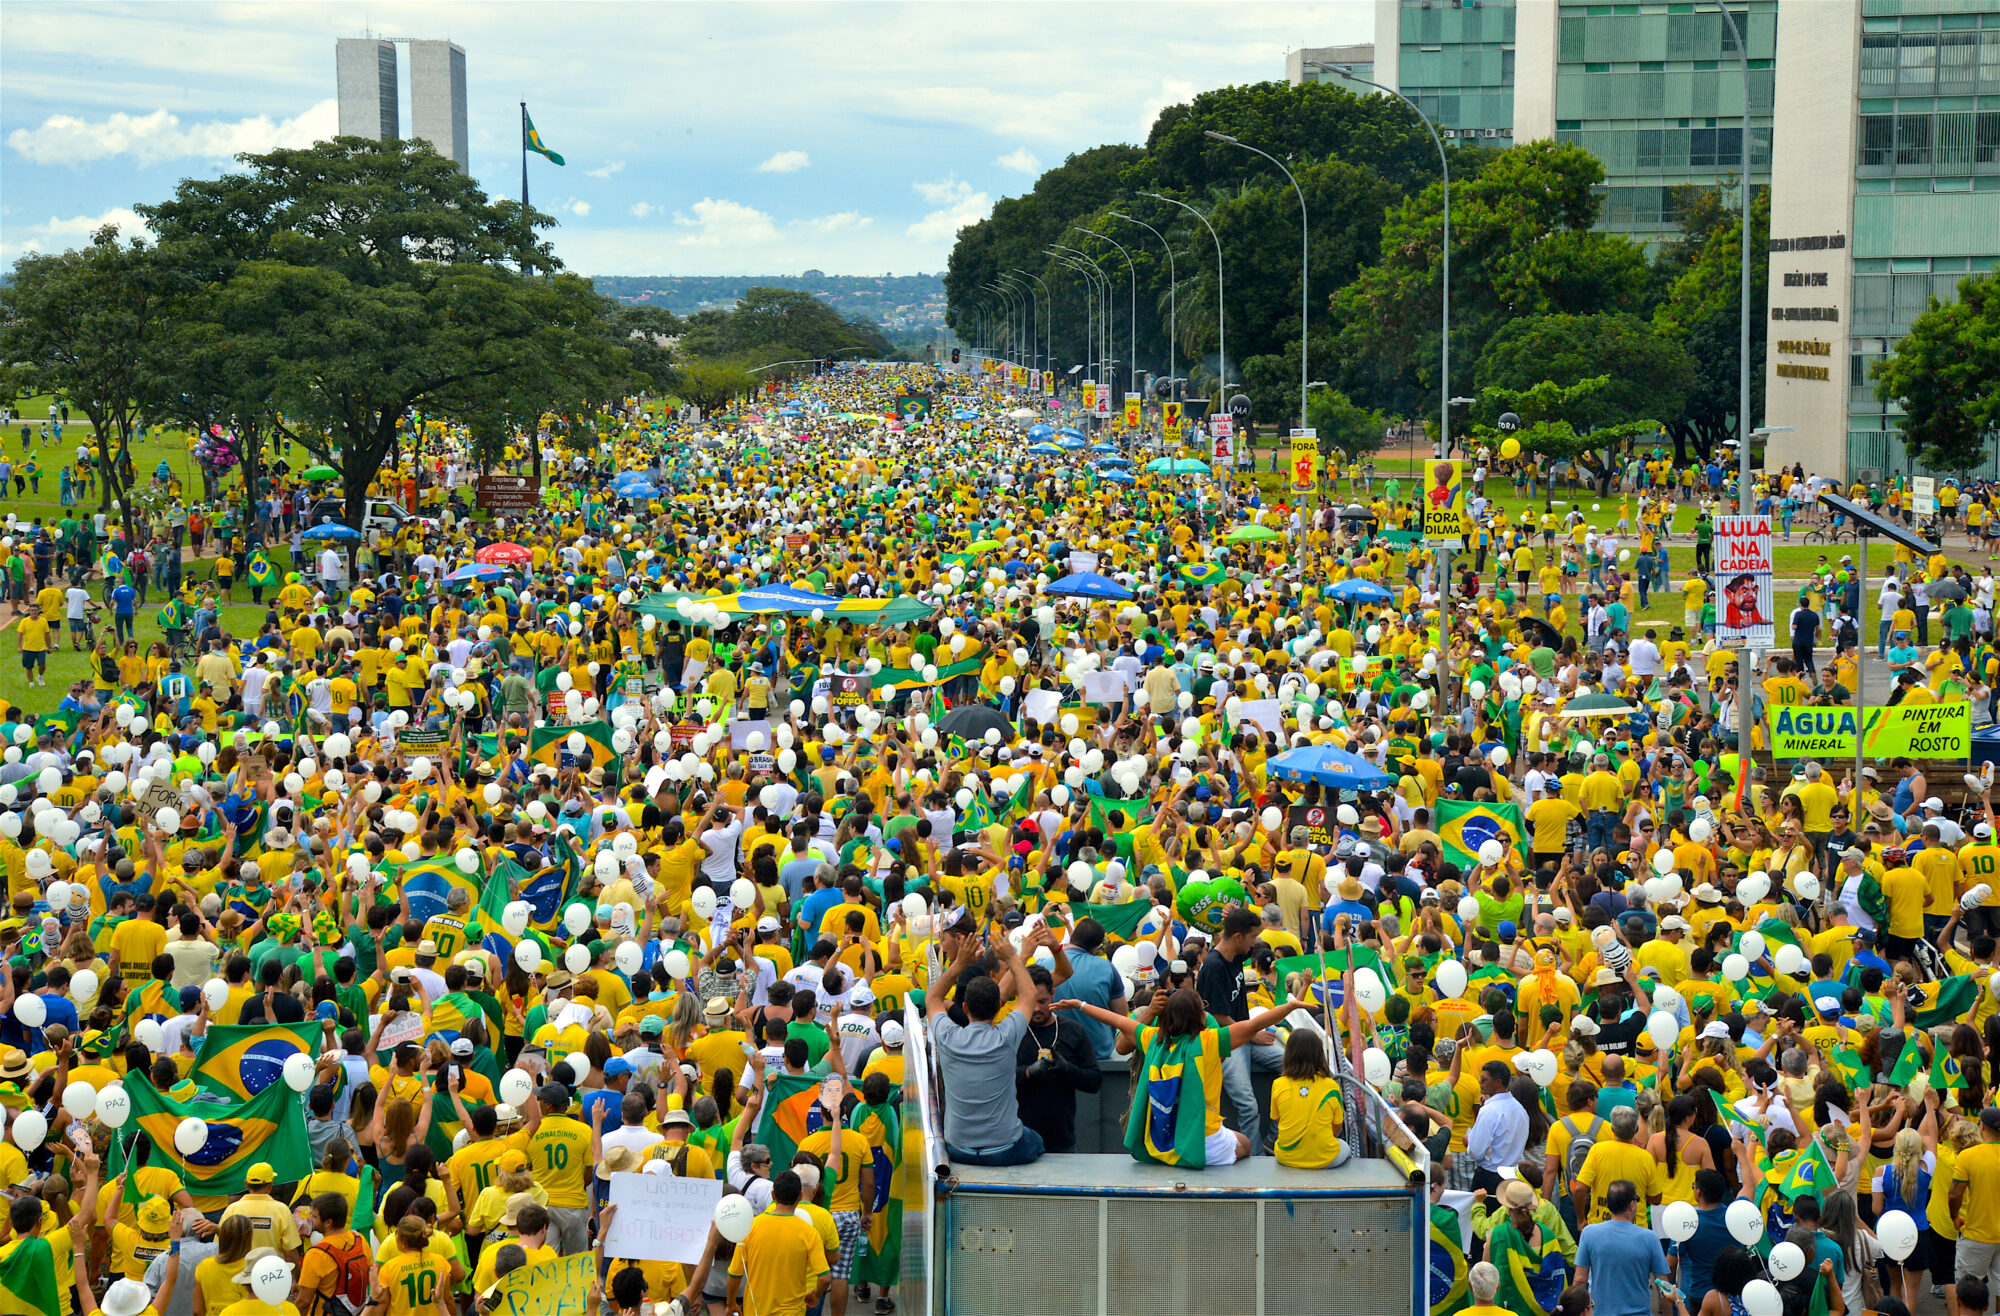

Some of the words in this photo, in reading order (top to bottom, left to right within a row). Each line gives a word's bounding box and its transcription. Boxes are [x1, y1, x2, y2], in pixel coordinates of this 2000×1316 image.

[1426, 513, 1460, 522] FORA
[1426, 526, 1460, 534] DILMA
[1720, 520, 1770, 537] LULA
[1731, 541, 1760, 556] NA
[1720, 559, 1770, 570] CADEIA
[598, 648, 606, 658] 10
[332, 691, 342, 704] 10
[1779, 686, 1796, 704] 10
[1903, 706, 1964, 720] PINTURA
[1776, 708, 1857, 736] ÁGUA
[1918, 722, 1940, 734] EM
[1784, 739, 1846, 750] MINERAL
[1908, 736, 1960, 752] ROSTO
[60, 794, 74, 806] 10
[150, 785, 182, 810] FORA
[1972, 855, 1994, 874] 10
[1804, 879, 1816, 888] PAZ
[964, 886, 984, 906] 10
[1190, 894, 1212, 915] ESSE
[512, 910, 526, 918] PAZ
[432, 932, 456, 958] 10
[874, 995, 898, 1014] 10
[1663, 998, 1676, 1007] PAZ
[841, 1023, 871, 1036] FORA
[1815, 1038, 1838, 1048] FOR
[1529, 1062, 1544, 1070] PAZ
[516, 1080, 530, 1090] PAZ
[105, 1099, 126, 1109] PAZ
[536, 1128, 578, 1142] RONALDINHO
[544, 1143, 568, 1170] 10
[401, 1260, 434, 1272] DULCIMAR
[1770, 1254, 1788, 1272] PAZ
[261, 1268, 285, 1284] PAZ
[401, 1270, 436, 1308] 10
